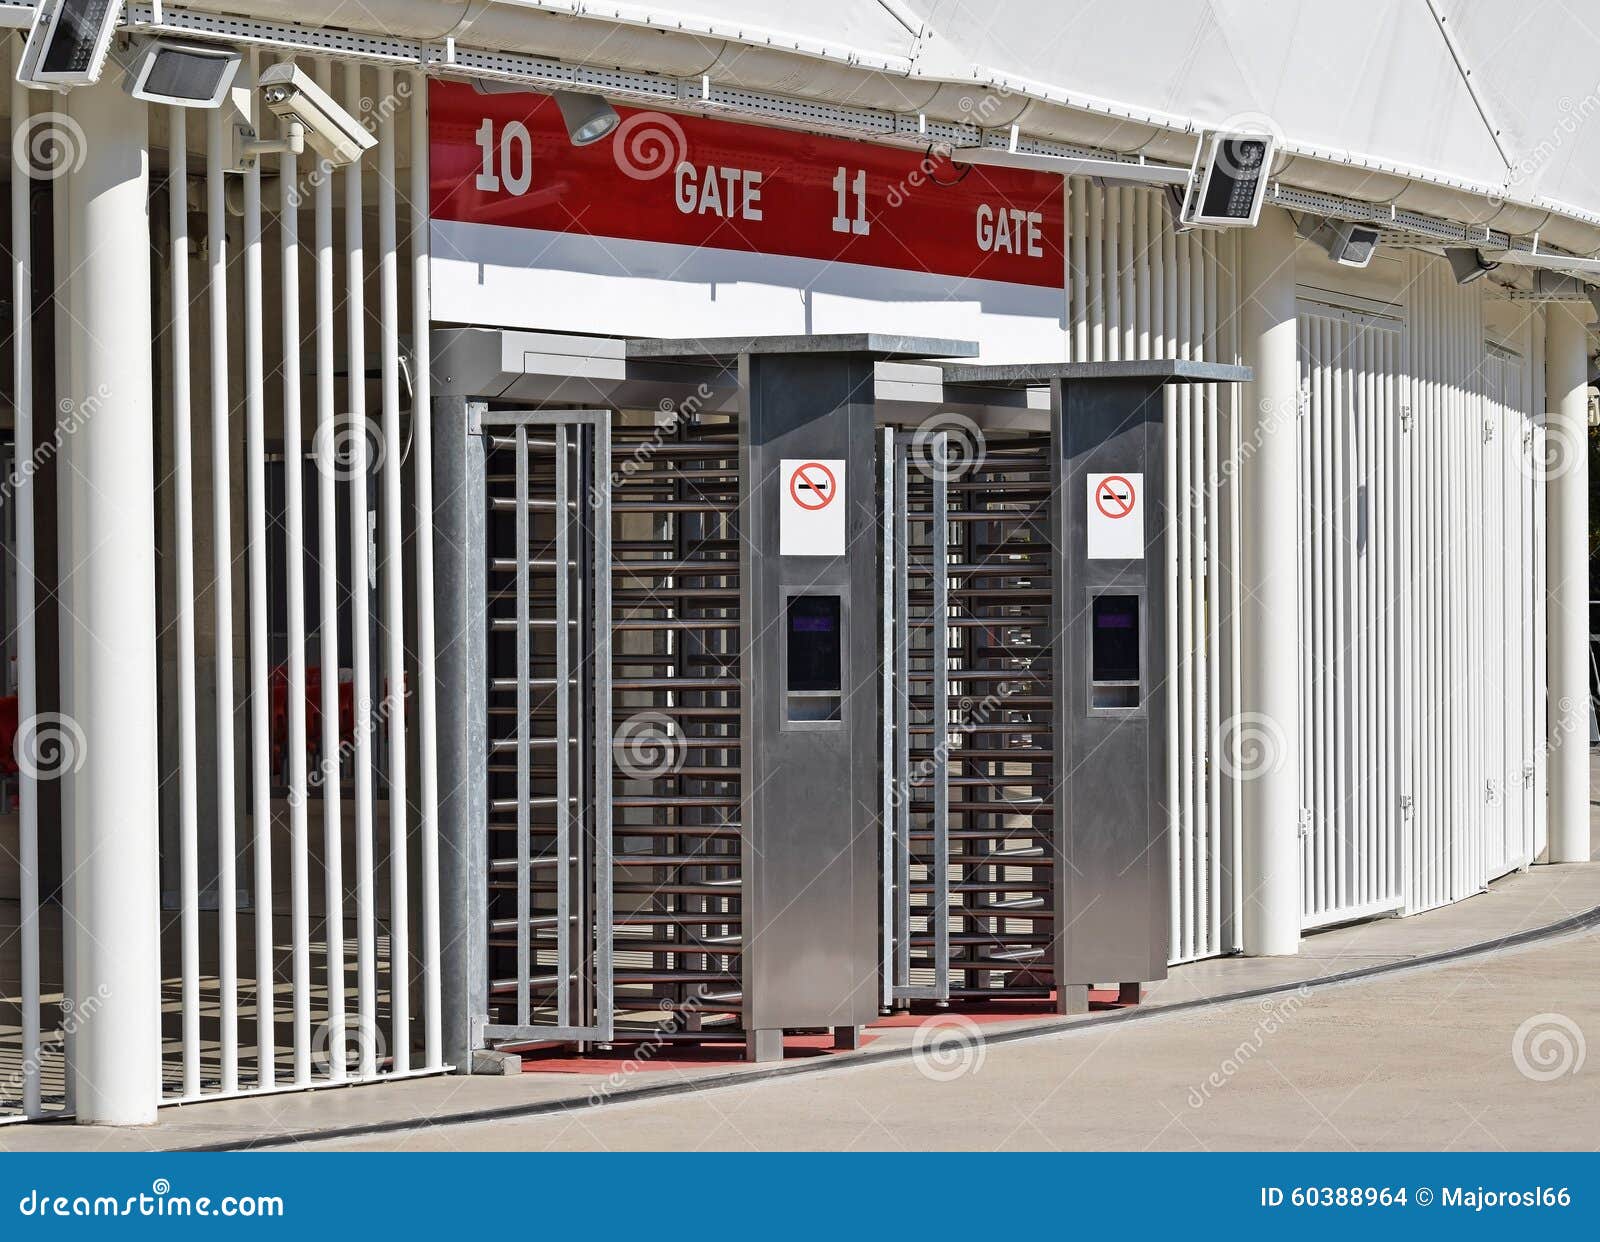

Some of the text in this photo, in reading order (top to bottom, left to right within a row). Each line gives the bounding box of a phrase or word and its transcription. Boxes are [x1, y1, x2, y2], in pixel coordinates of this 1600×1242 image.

[475, 118, 1044, 258] 10 GATE 11 GATE
